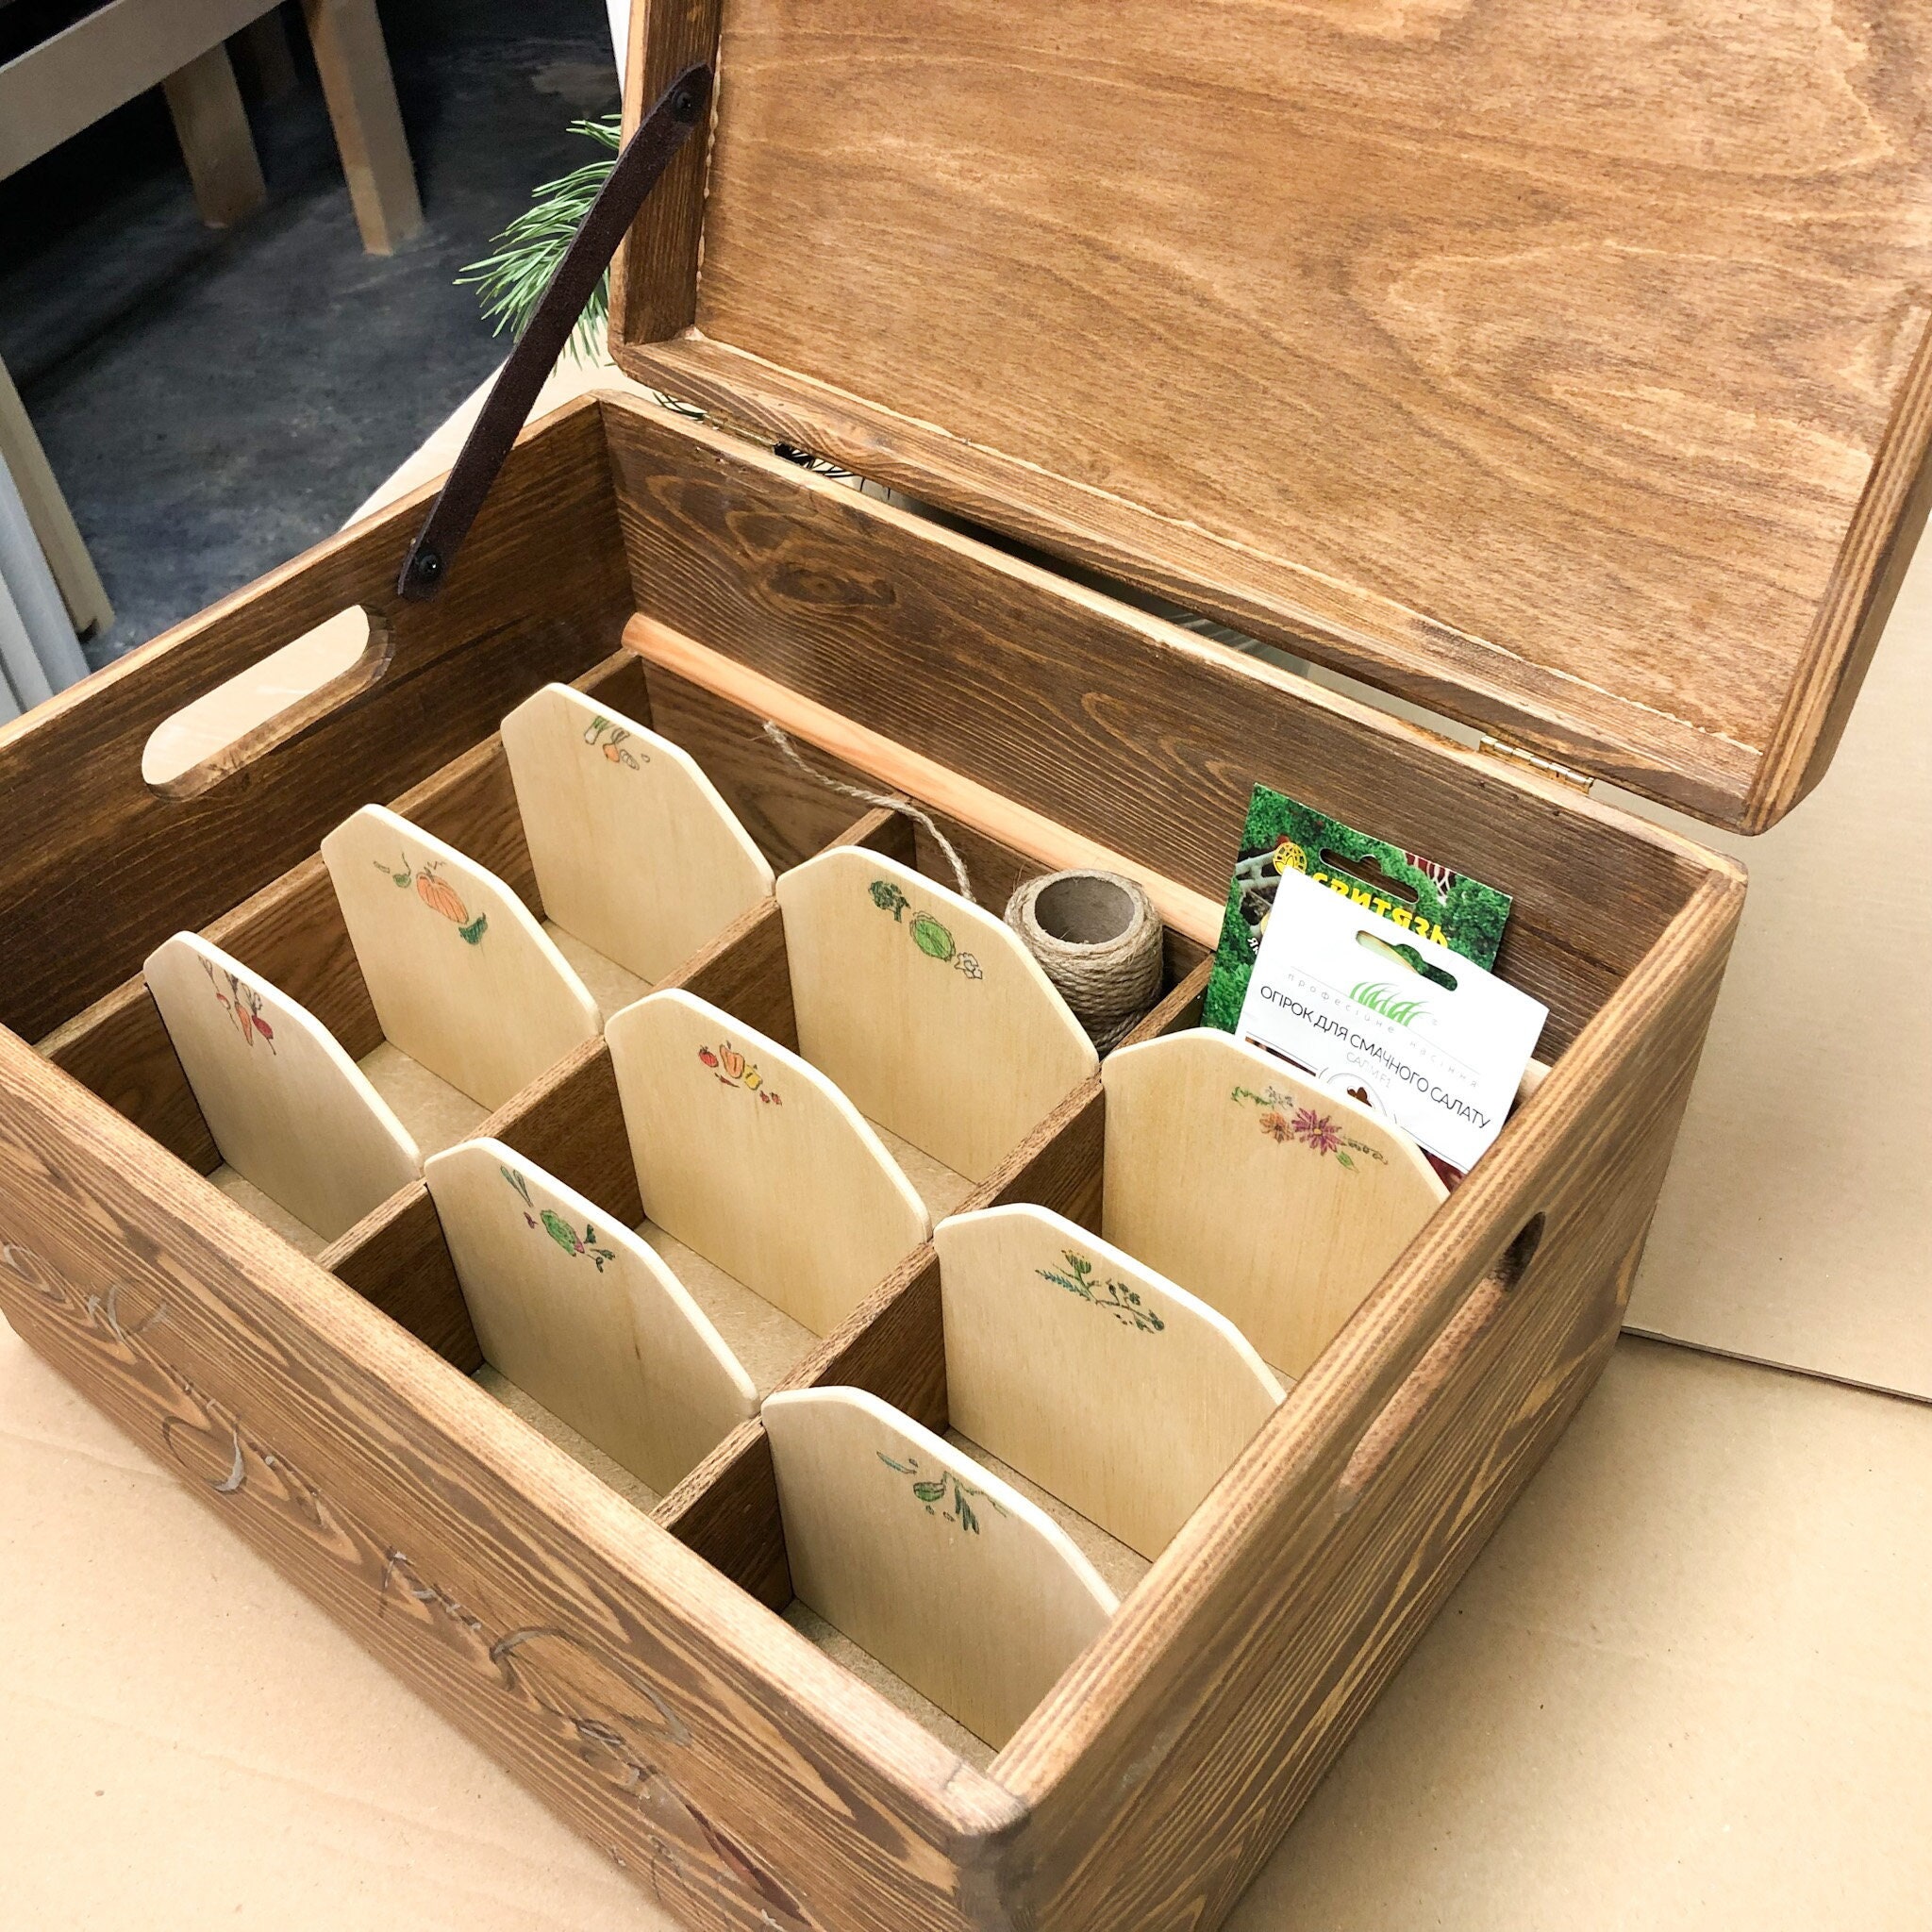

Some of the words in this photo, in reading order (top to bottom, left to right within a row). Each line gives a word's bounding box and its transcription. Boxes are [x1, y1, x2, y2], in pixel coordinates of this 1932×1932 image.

[1260, 985, 1314, 1020] ОГІРОК
[1314, 1012, 1349, 1041] ДЛЯ
[1350, 1032, 1429, 1093] СМАЧНОГО
[1429, 1086, 1491, 1129] САЛАТУ
